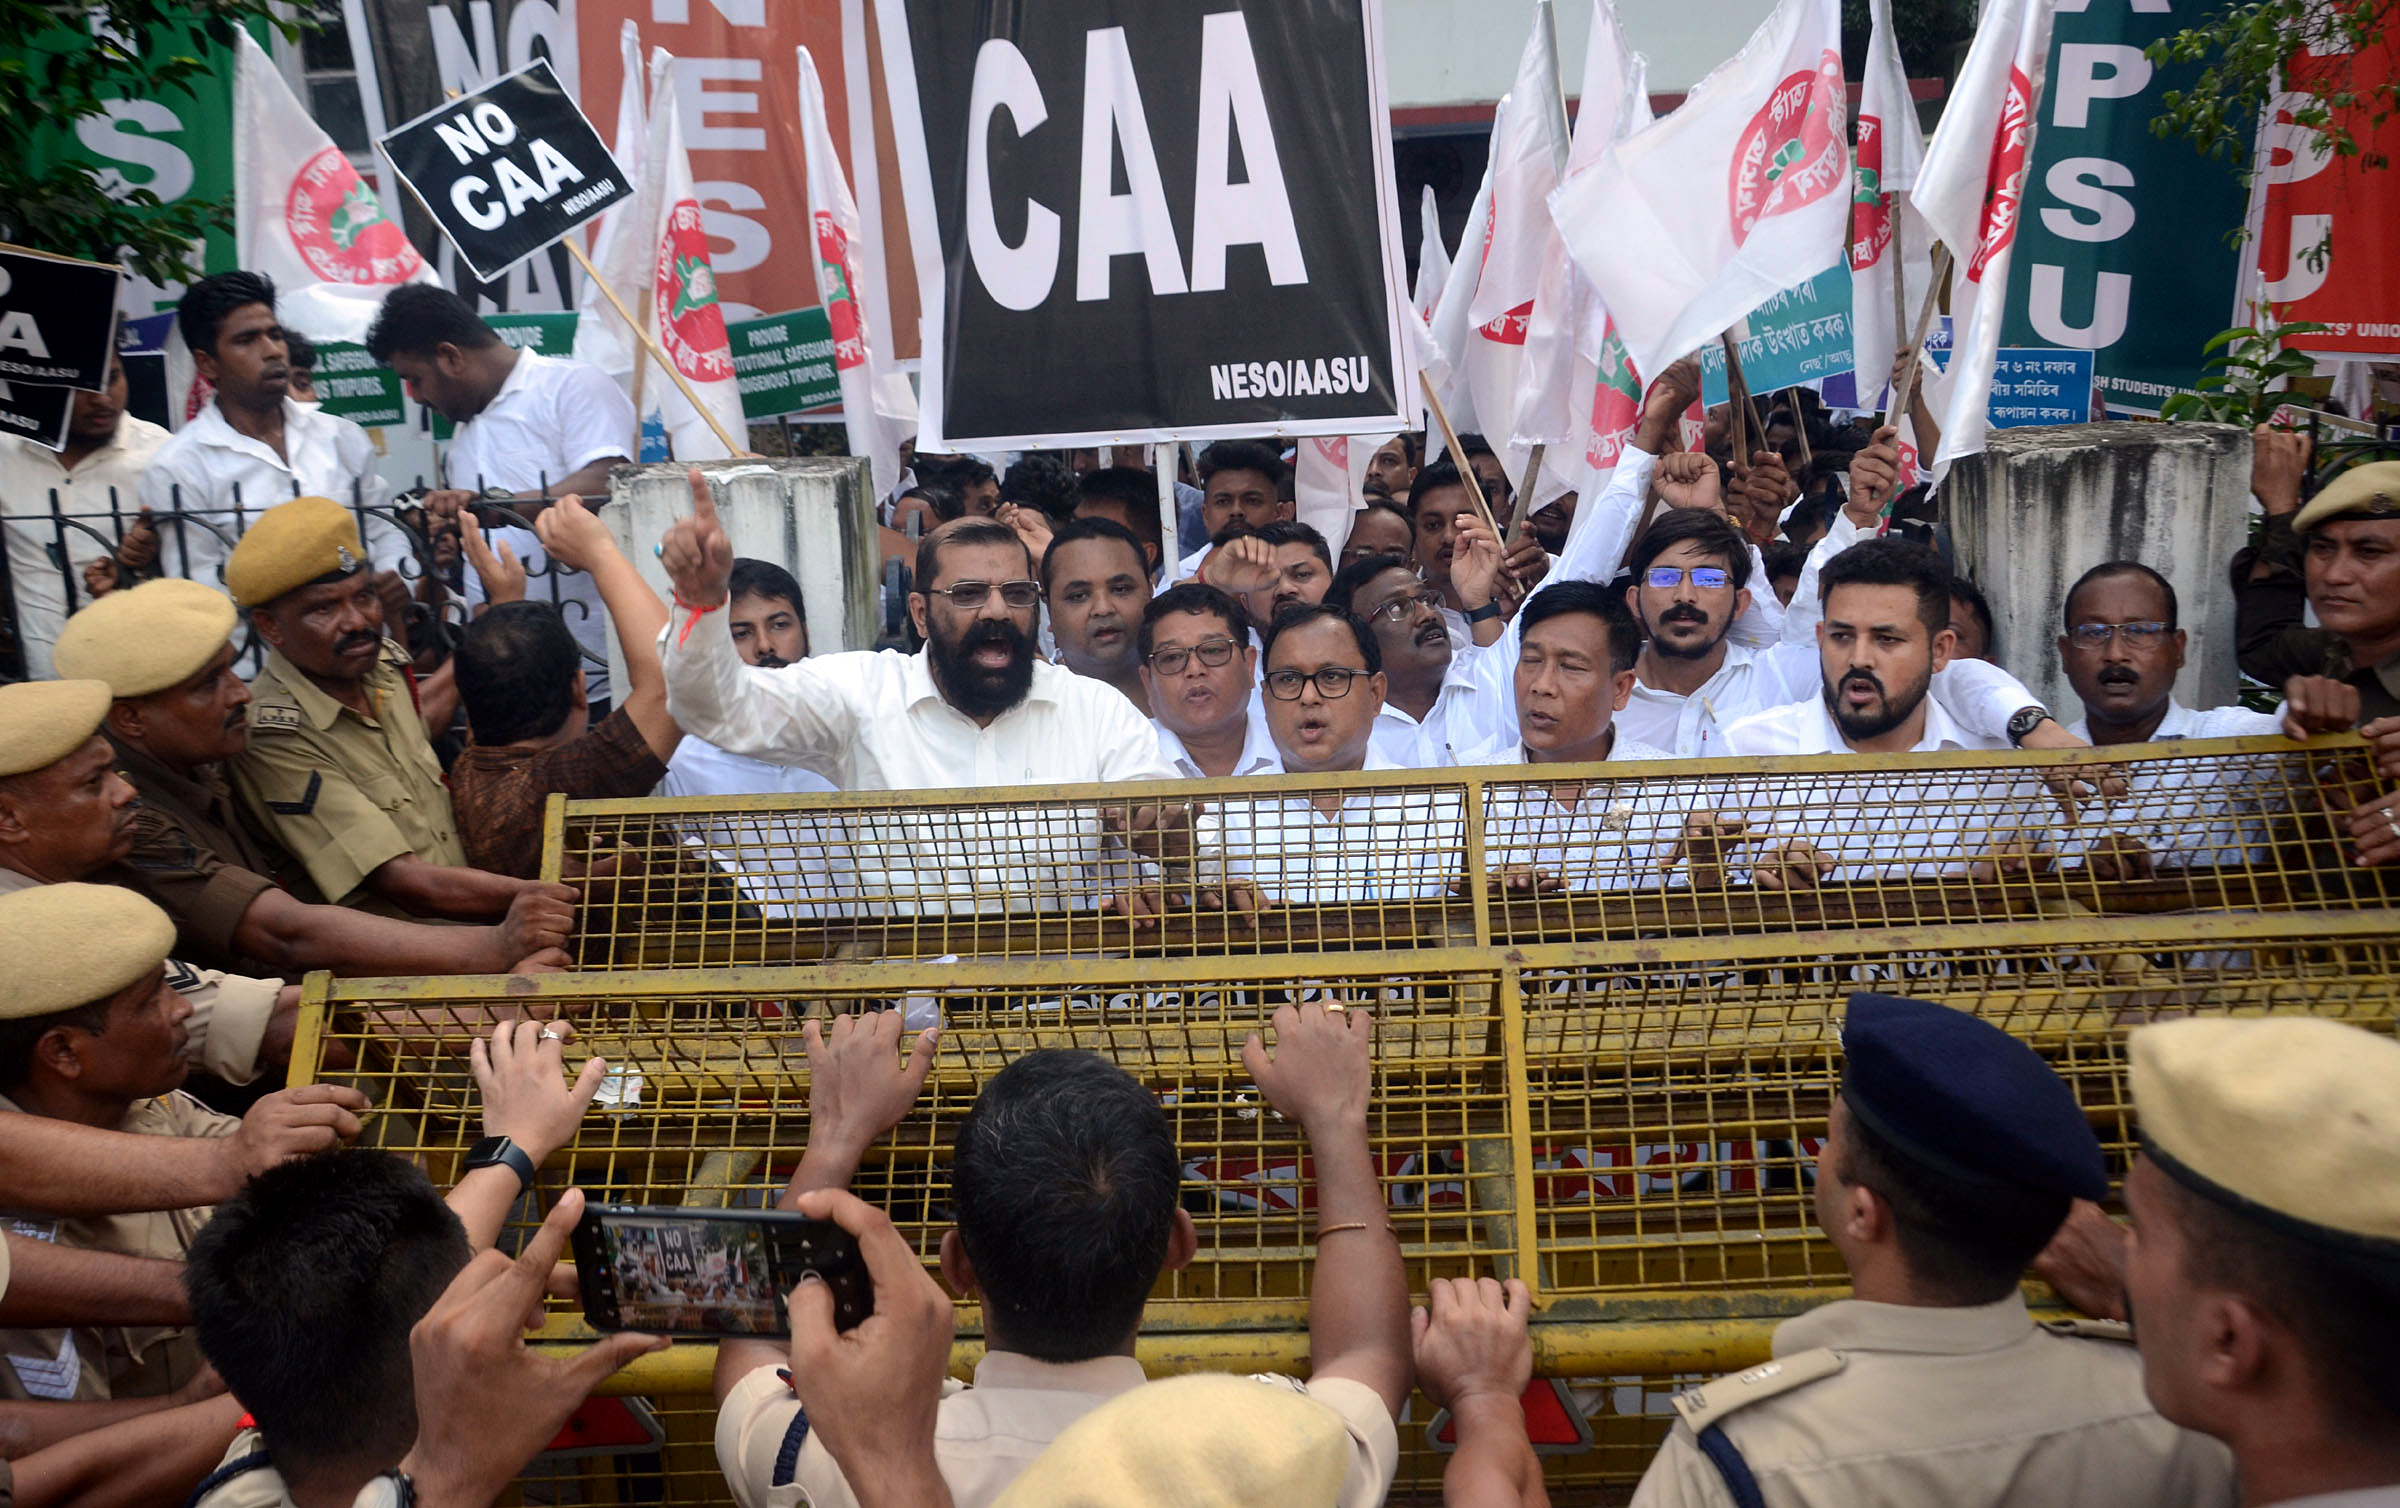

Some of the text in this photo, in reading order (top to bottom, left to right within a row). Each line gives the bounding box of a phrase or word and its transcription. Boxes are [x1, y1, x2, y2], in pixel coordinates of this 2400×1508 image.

[434, 102, 517, 166] NO
[966, 11, 1309, 311] CAA
[2029, 0, 2172, 349] PSU
[450, 138, 586, 231] CAA
[560, 178, 616, 217] NESO/AASU
[2357, 323, 2400, 338] UNIO
[0, 361, 80, 379] ESO/AASU
[1211, 356, 1370, 400] NESO/AASU
[664, 1231, 682, 1248] NO
[665, 1252, 692, 1272] CAA
